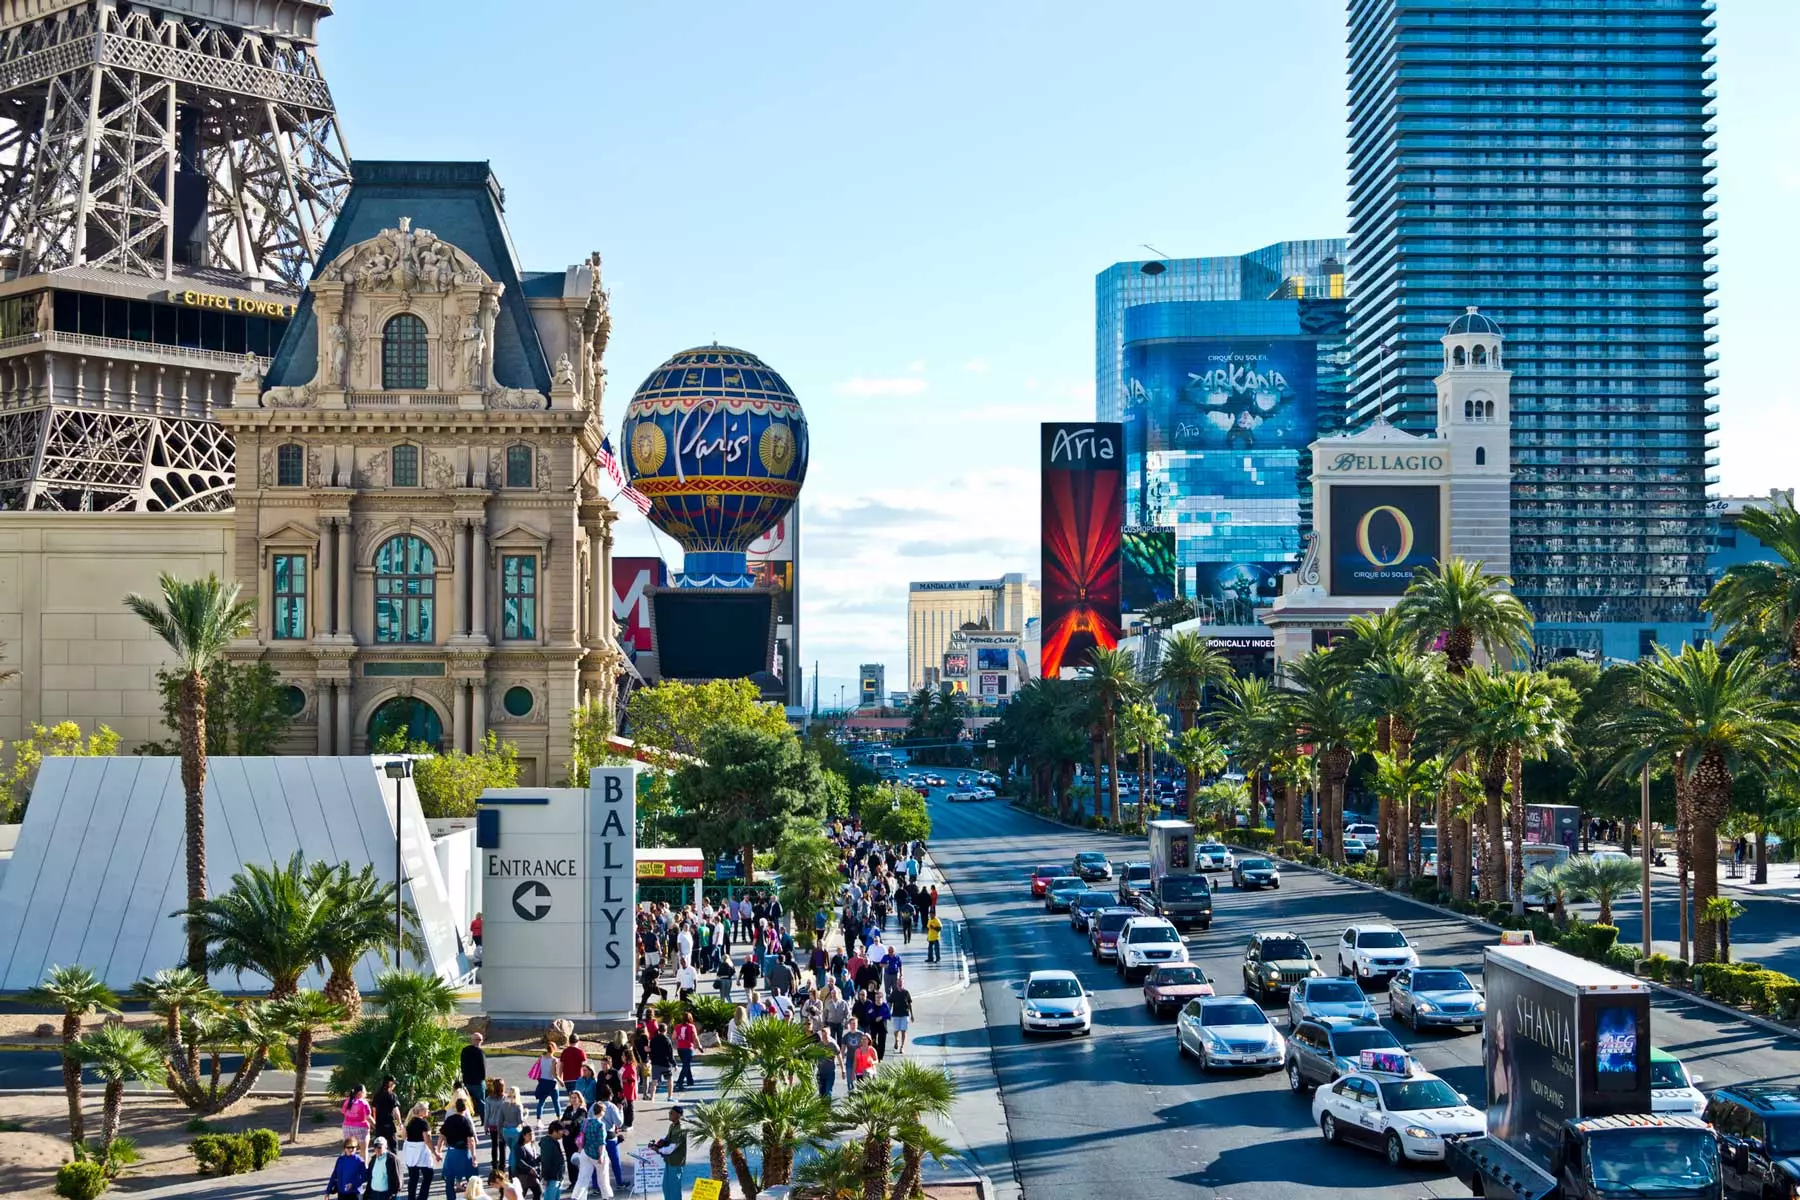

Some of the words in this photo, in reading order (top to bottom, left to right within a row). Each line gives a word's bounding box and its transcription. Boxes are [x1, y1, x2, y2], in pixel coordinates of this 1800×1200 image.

[184, 290, 232, 310] EIFFEL
[236, 296, 284, 316] TOWER
[1208, 354, 1232, 362] CIRQUE
[675, 397, 749, 483] Paris
[1175, 422, 1200, 439] Aria
[1051, 429, 1114, 463] Aria
[1328, 452, 1443, 471] BELLAGIO
[1123, 525, 1175, 533] COSMOPOLITAN
[1355, 505, 1414, 567] O
[1353, 571, 1380, 579] CIRQUE
[952, 632, 967, 640] NEW
[952, 641, 967, 649] NEW
[488, 854, 577, 876] ENTRANCE
[600, 775, 626, 969] BALLYS
[1516, 994, 1573, 1060] SHANIA
[1530, 1076, 1544, 1097] NOW
[1417, 1109, 1475, 1120] 193
